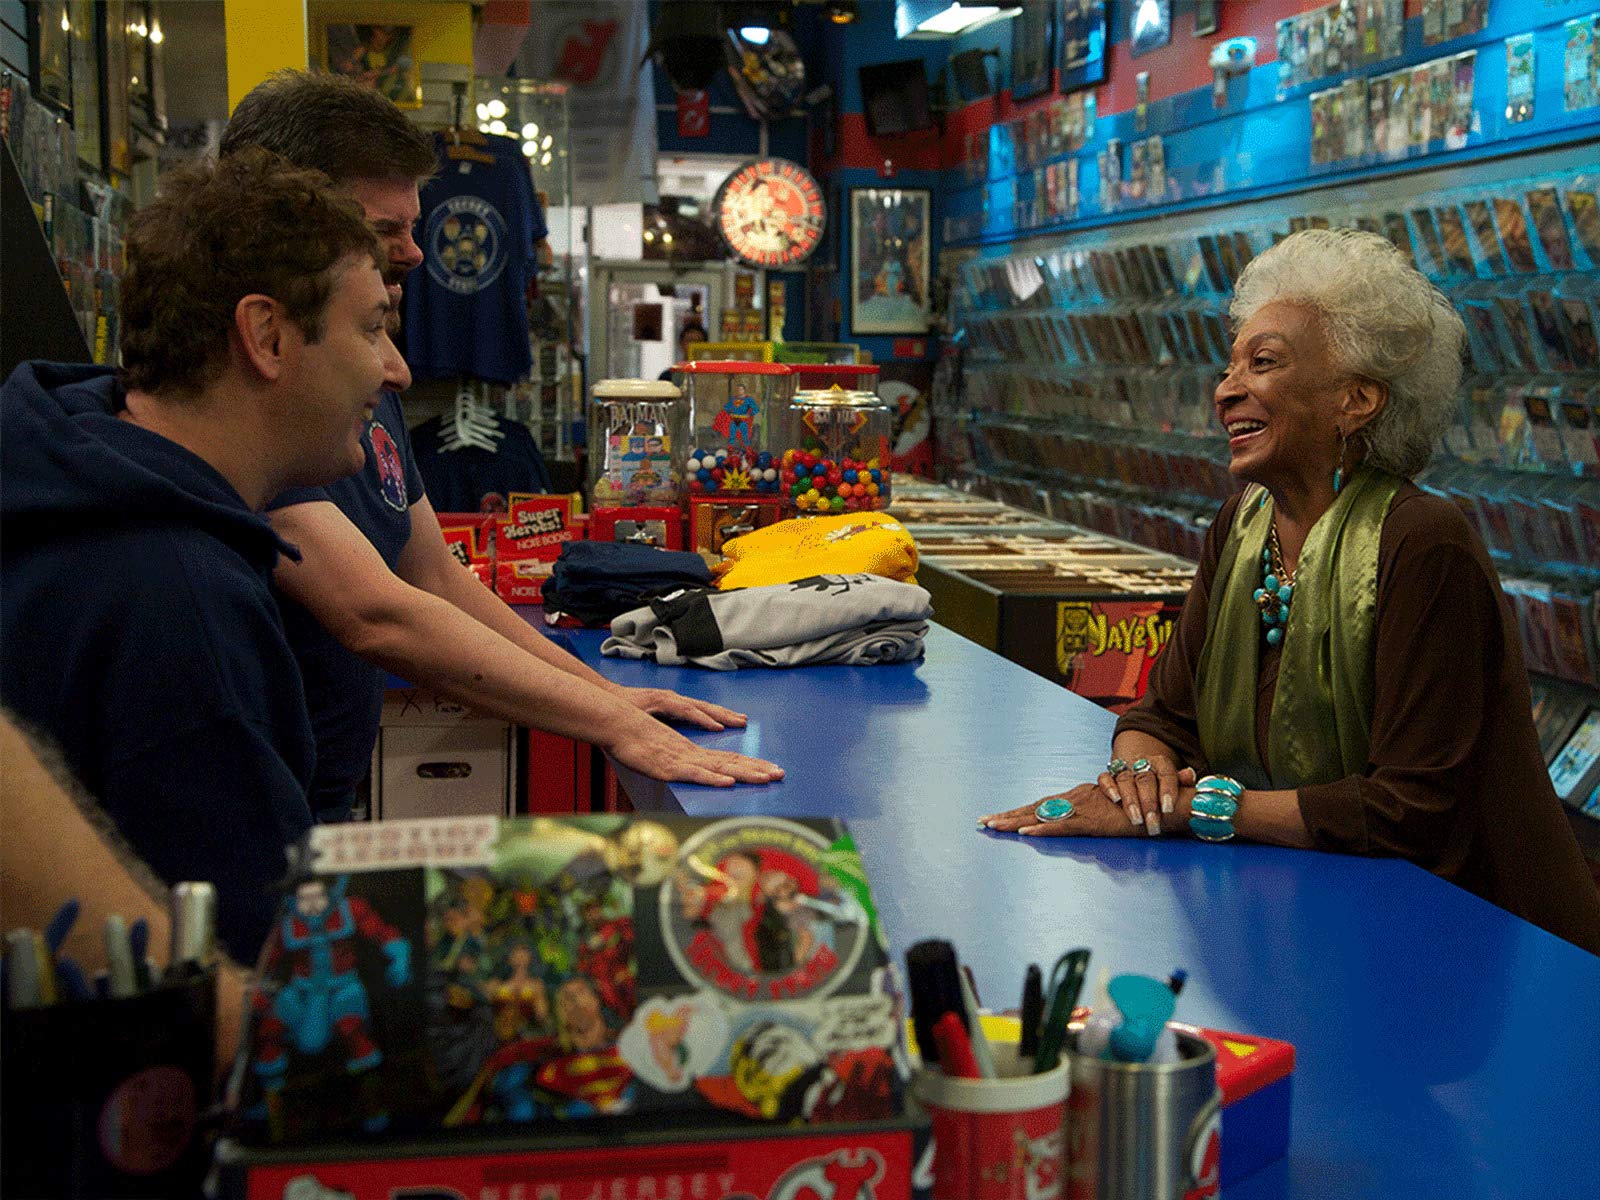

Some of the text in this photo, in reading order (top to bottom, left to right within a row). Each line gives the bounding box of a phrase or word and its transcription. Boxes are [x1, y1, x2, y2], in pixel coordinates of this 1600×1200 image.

[610, 404, 669, 434] BATMAN
[518, 507, 560, 524] Super
[502, 516, 563, 539] Heroes!
[516, 531, 572, 550] NOTE BOOKS
[511, 587, 536, 597] NOTE
